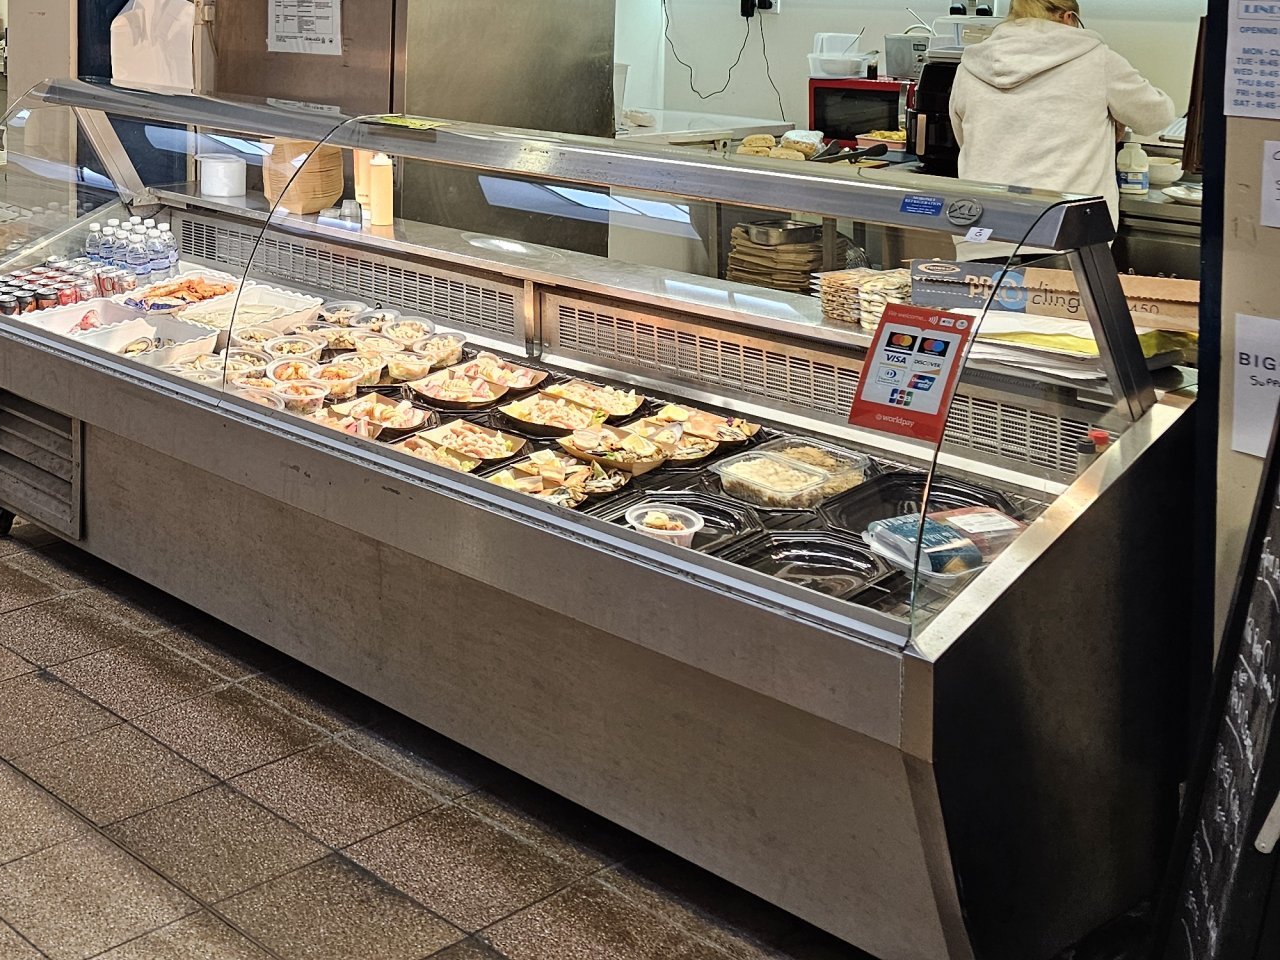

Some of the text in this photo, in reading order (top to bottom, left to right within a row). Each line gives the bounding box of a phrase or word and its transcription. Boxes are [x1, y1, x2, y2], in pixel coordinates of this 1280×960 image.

[1240, 26, 1278, 35] OPENING
[1242, 47, 1263, 55] MON
[1236, 57, 1253, 65] TUE
[1233, 68, 1253, 76] WED
[1237, 78, 1254, 87] THU
[1233, 99, 1250, 107] SAT
[1031, 289, 1081, 314] cling
[886, 353, 907, 364] VISA
[913, 359, 941, 369] DISCOVER
[882, 414, 915, 428] worldpay
